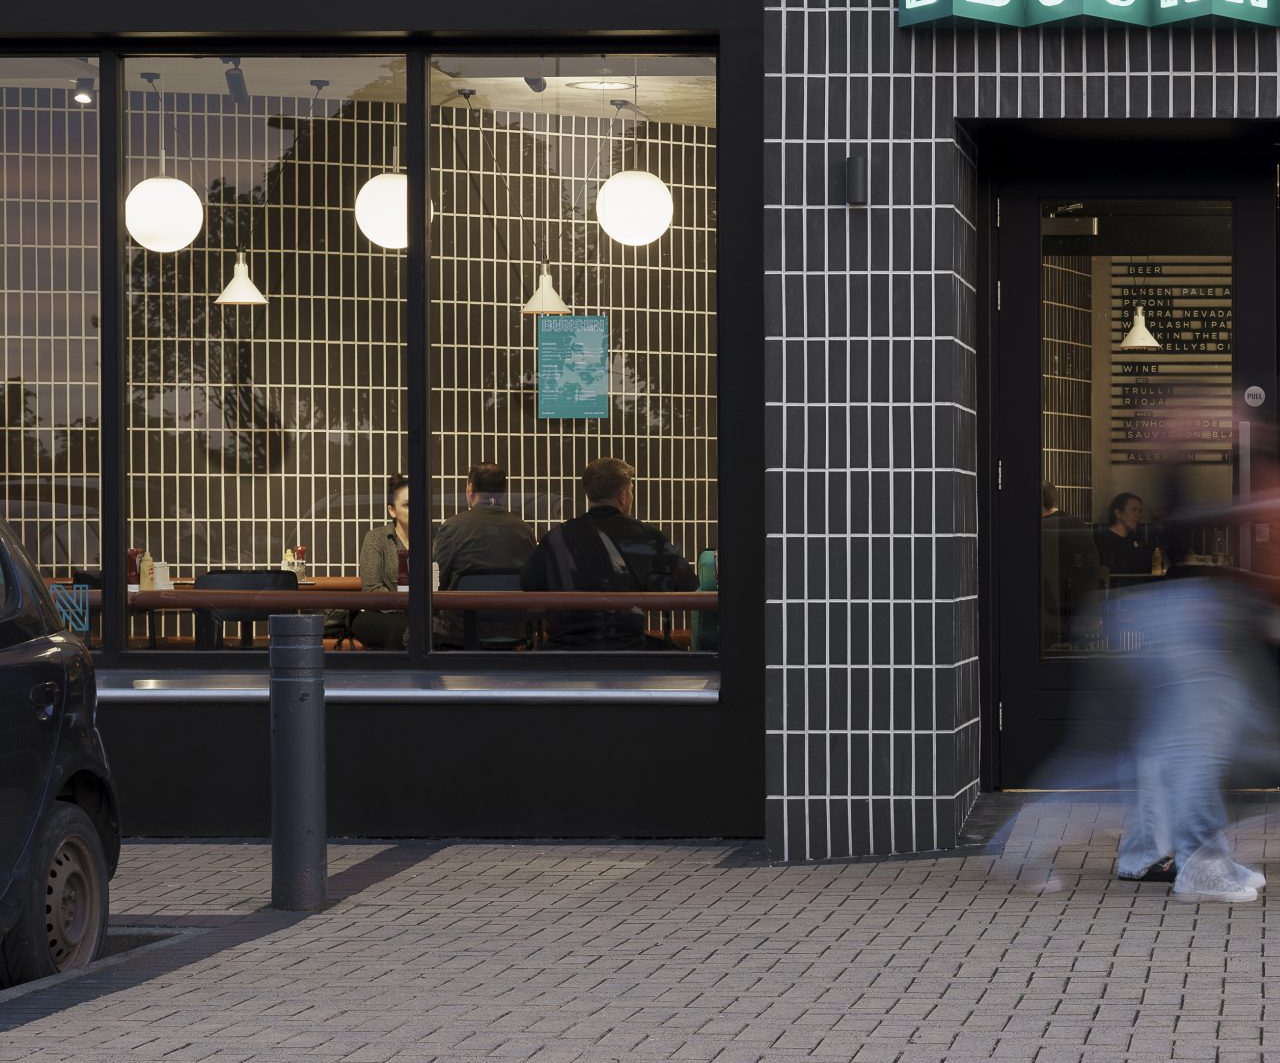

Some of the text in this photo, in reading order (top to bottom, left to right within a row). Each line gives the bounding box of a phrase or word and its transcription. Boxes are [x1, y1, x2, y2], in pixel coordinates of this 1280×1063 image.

[1129, 266, 1162, 274] BEER
[1123, 288, 1171, 296] BUNSEN
[1182, 288, 1214, 296] PALE
[1124, 299, 1170, 307] PERONI
[1184, 310, 1232, 318] NEVADA
[542, 319, 605, 332] BUNSEN
[1122, 321, 1226, 329] WPLASH IPA
[1194, 332, 1218, 340] THE
[1123, 365, 1158, 373] WINE
[1123, 387, 1171, 395] TRULLI
[1124, 398, 1165, 406] RIOJA
[1127, 431, 1201, 439] SAUVION
[1129, 453, 1195, 461] ALLEEN
